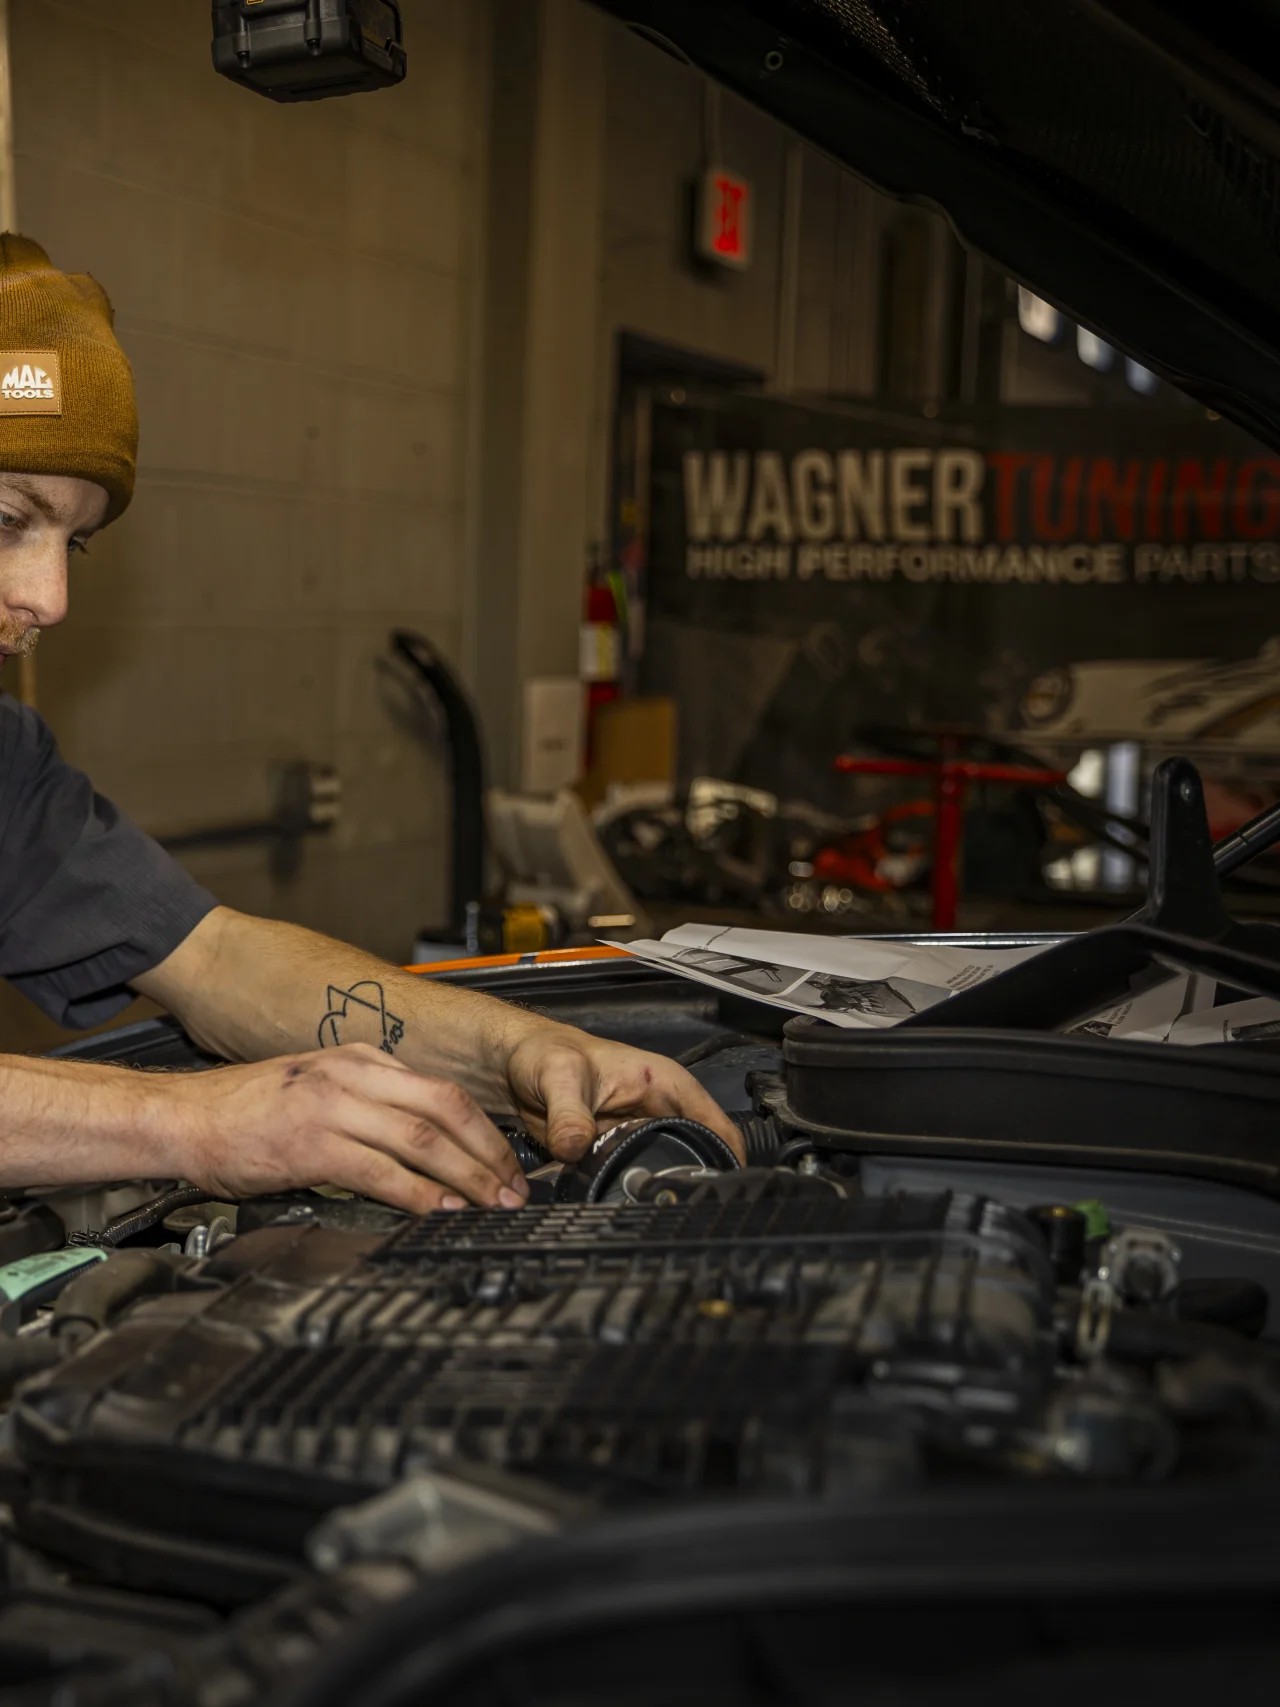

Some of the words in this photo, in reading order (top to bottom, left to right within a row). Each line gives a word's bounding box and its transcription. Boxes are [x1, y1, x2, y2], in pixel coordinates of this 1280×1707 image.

[1, 364, 54, 390] MAC
[1, 389, 55, 400] TOOLS
[682, 448, 985, 543] WAGNER
[685, 543, 791, 581] HIGH
[797, 542, 1128, 583] PERFORMANCE
[1133, 542, 1280, 584] PARTS
